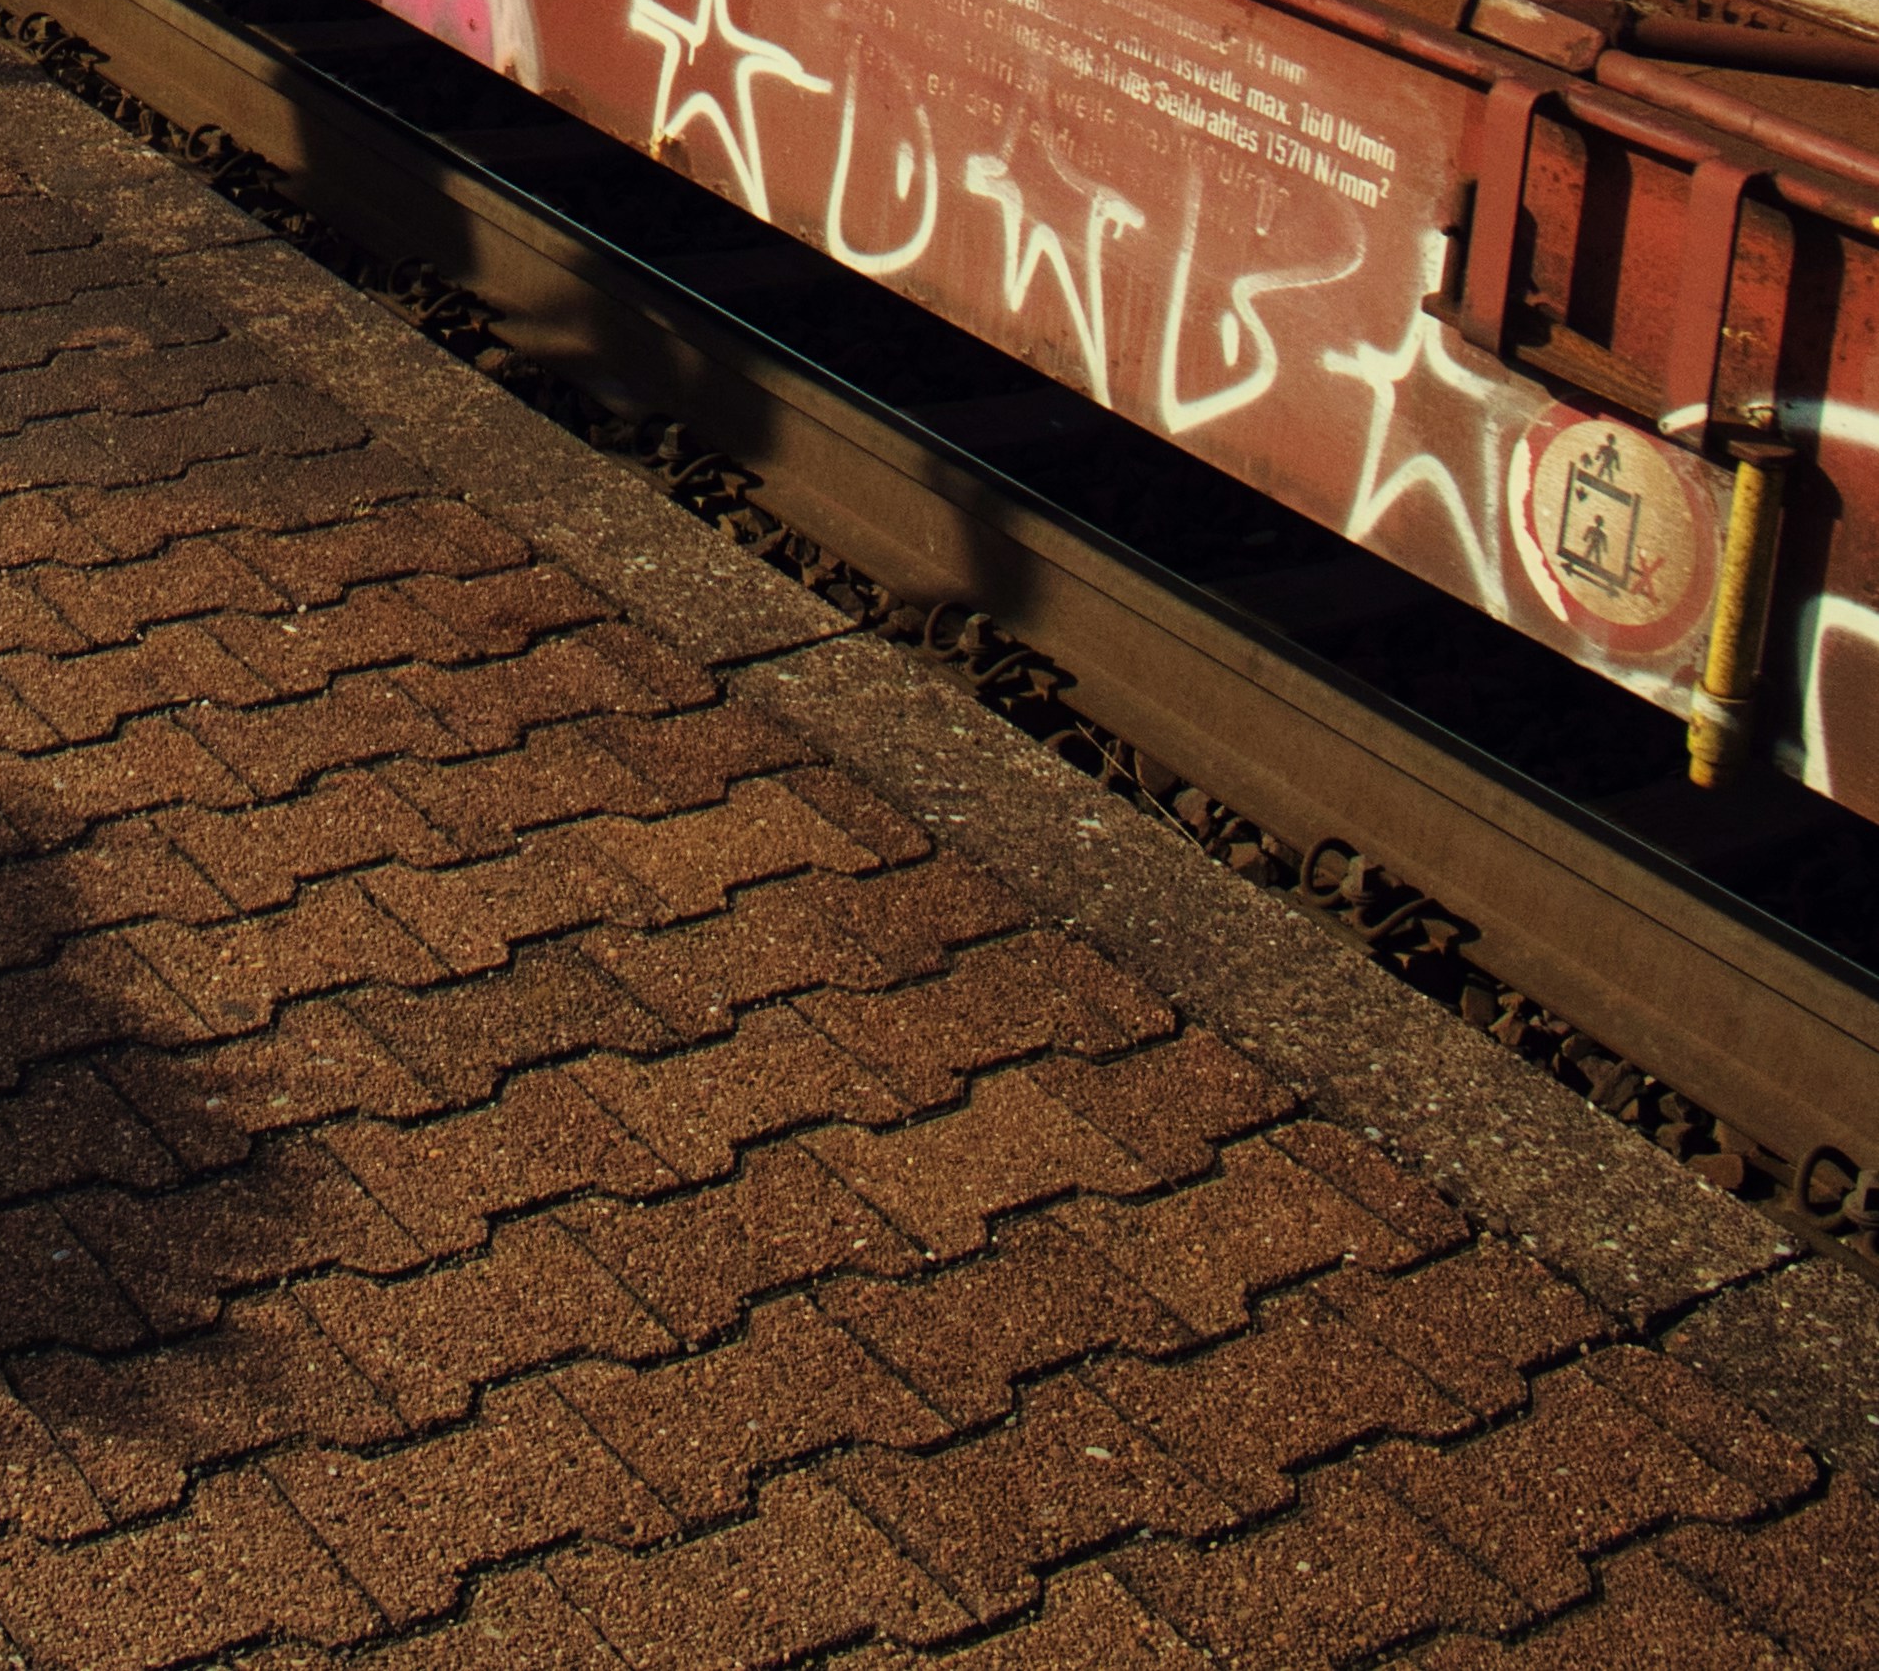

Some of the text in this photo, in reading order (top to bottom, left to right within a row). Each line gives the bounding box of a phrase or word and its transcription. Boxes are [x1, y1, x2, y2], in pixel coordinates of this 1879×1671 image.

[1265, 130, 1313, 175] 1570
[1300, 101, 1334, 143] 160
[1337, 117, 1397, 173] U/min
